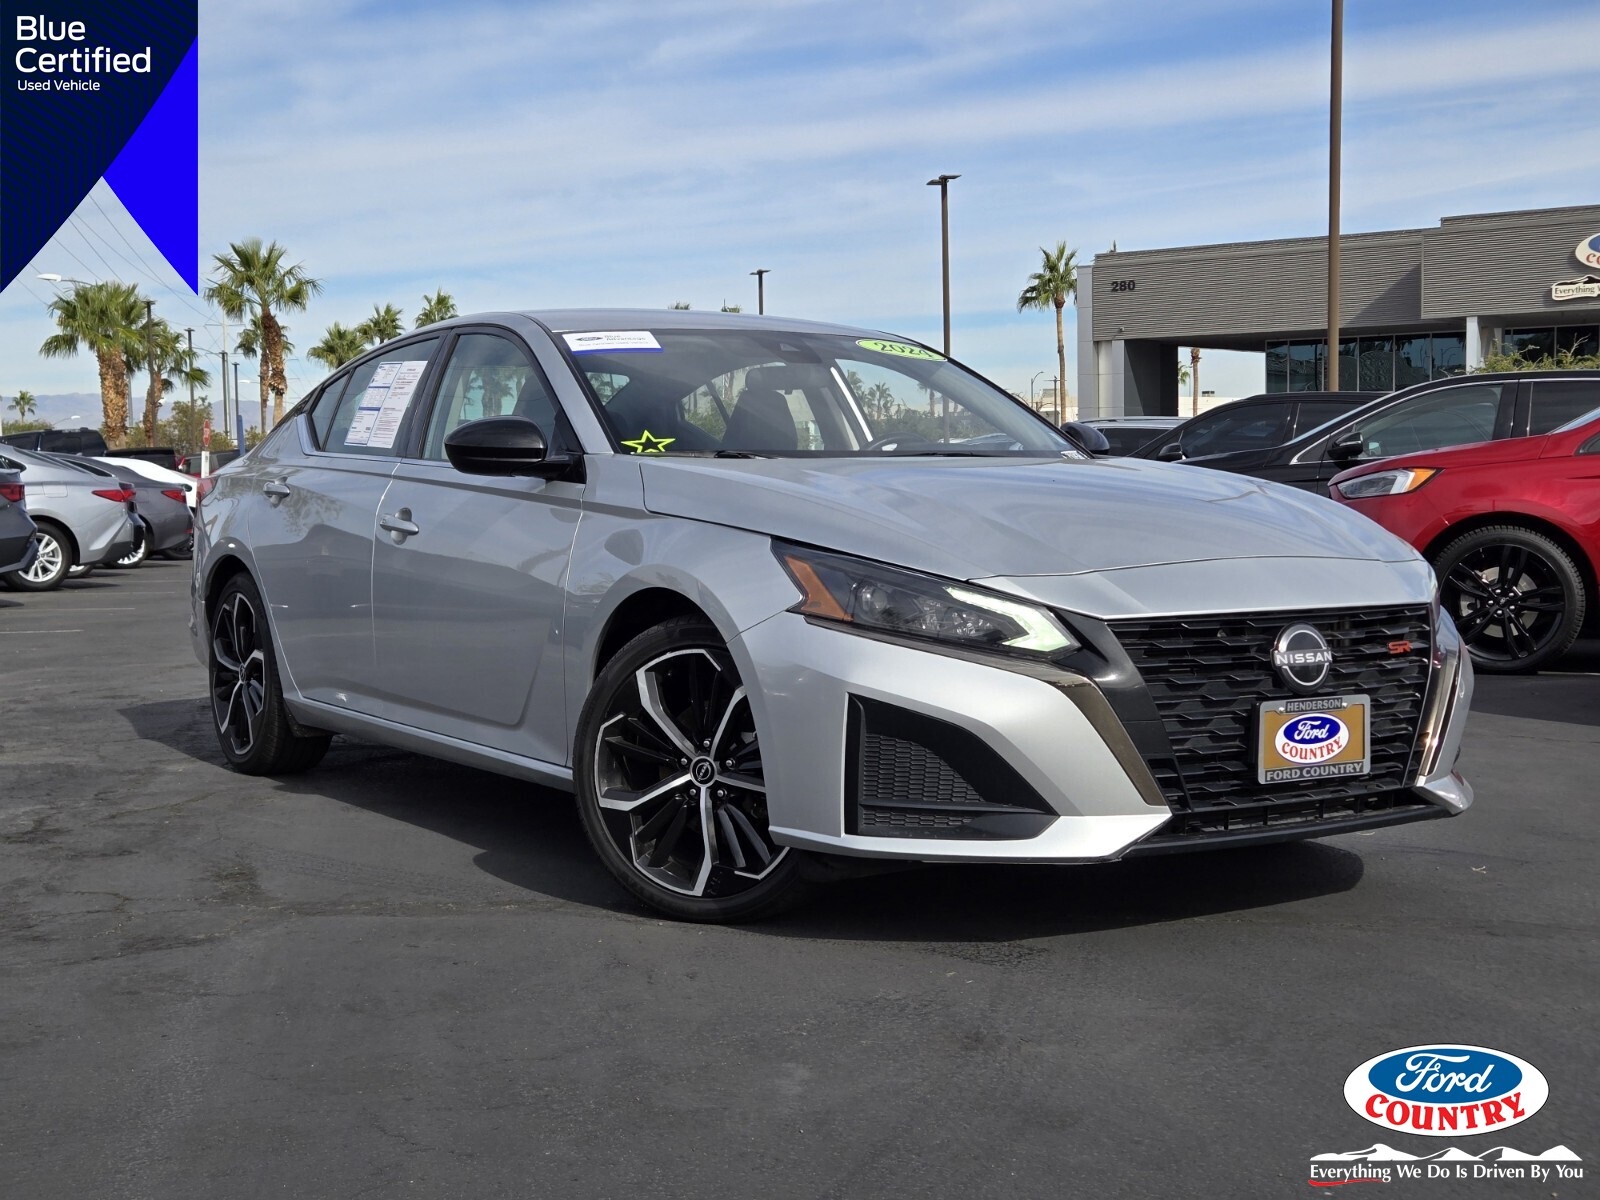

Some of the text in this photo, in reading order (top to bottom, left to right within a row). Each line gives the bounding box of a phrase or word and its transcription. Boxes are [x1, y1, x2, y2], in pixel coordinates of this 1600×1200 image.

[1111, 280, 1136, 292] 280
[1554, 286, 1595, 295] Everything
[1388, 641, 1411, 654] SR
[1275, 651, 1333, 665] NISSAN
[1287, 699, 1342, 712] HENDERSON
[1294, 720, 1331, 740] Ford
[1282, 736, 1343, 760] COUNTRY
[1266, 762, 1363, 781] FORD COUNTRY
